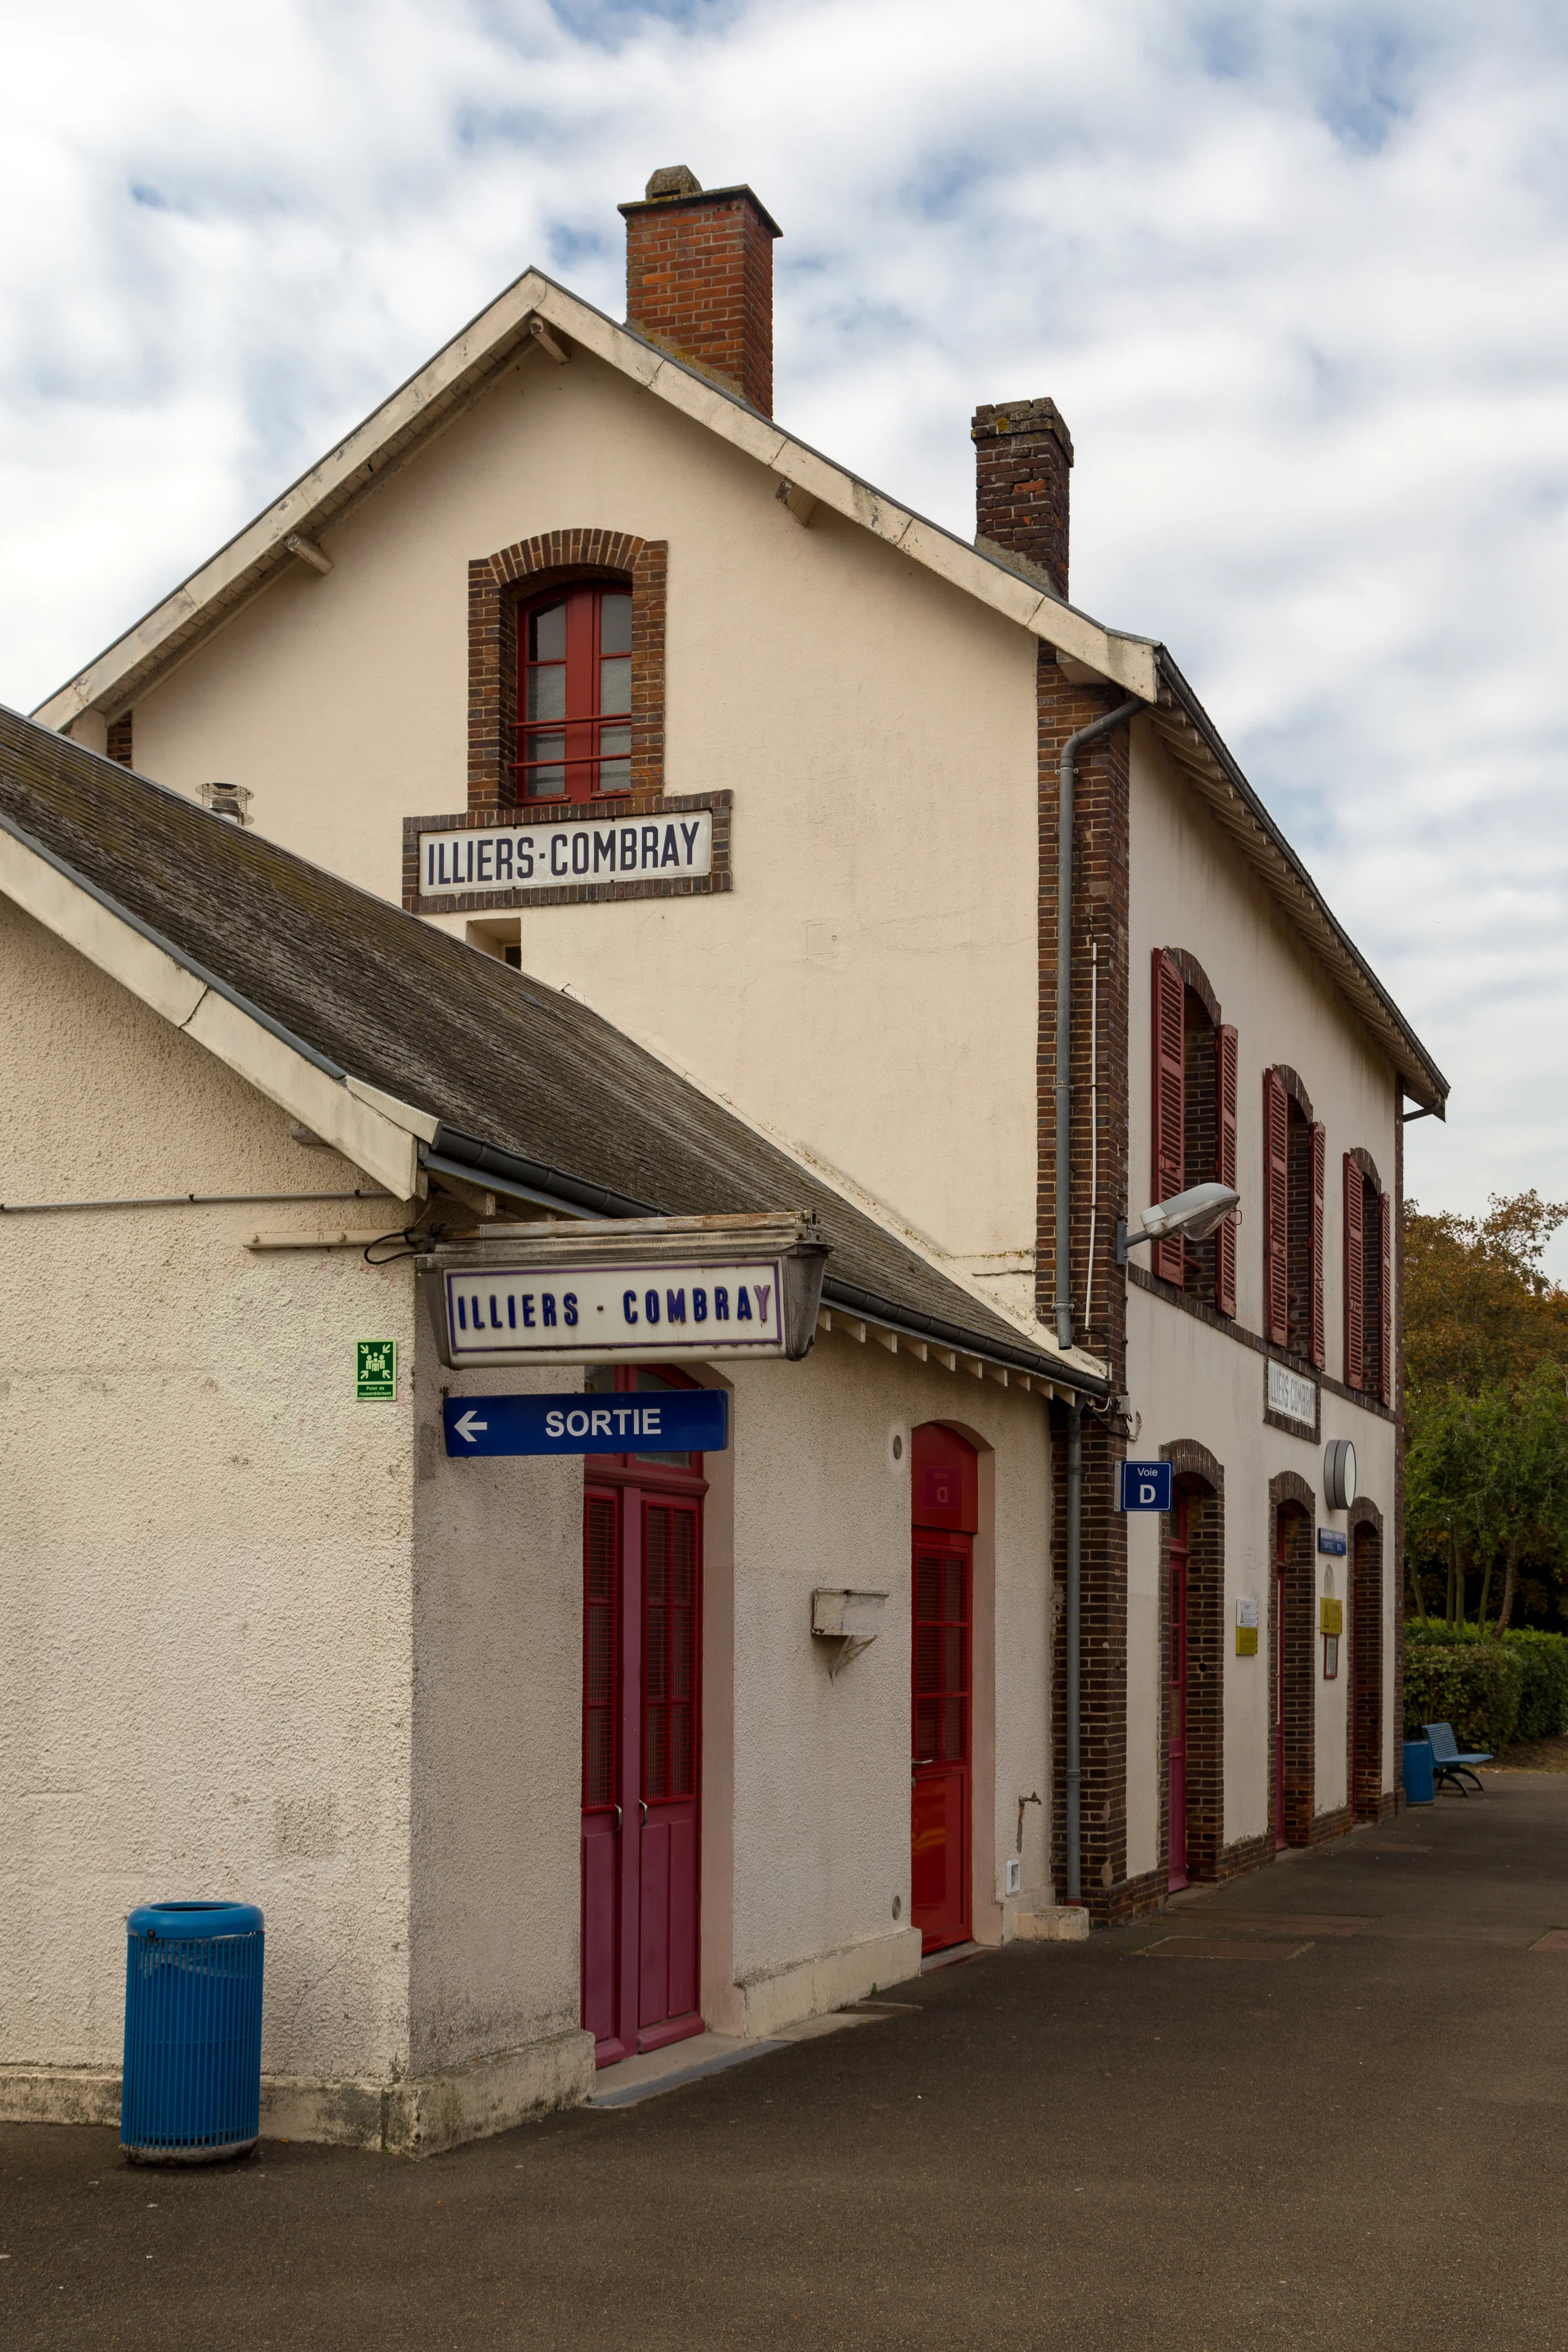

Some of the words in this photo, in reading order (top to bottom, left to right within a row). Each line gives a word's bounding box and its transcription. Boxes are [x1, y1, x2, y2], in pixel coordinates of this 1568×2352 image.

[457, 1292, 578, 1330] ILLIERS
[623, 1285, 771, 1325] COMBRAY
[544, 1408, 662, 1437] SORTIE
[1137, 1468, 1158, 1476] Voie
[1139, 1485, 1156, 1503] D
